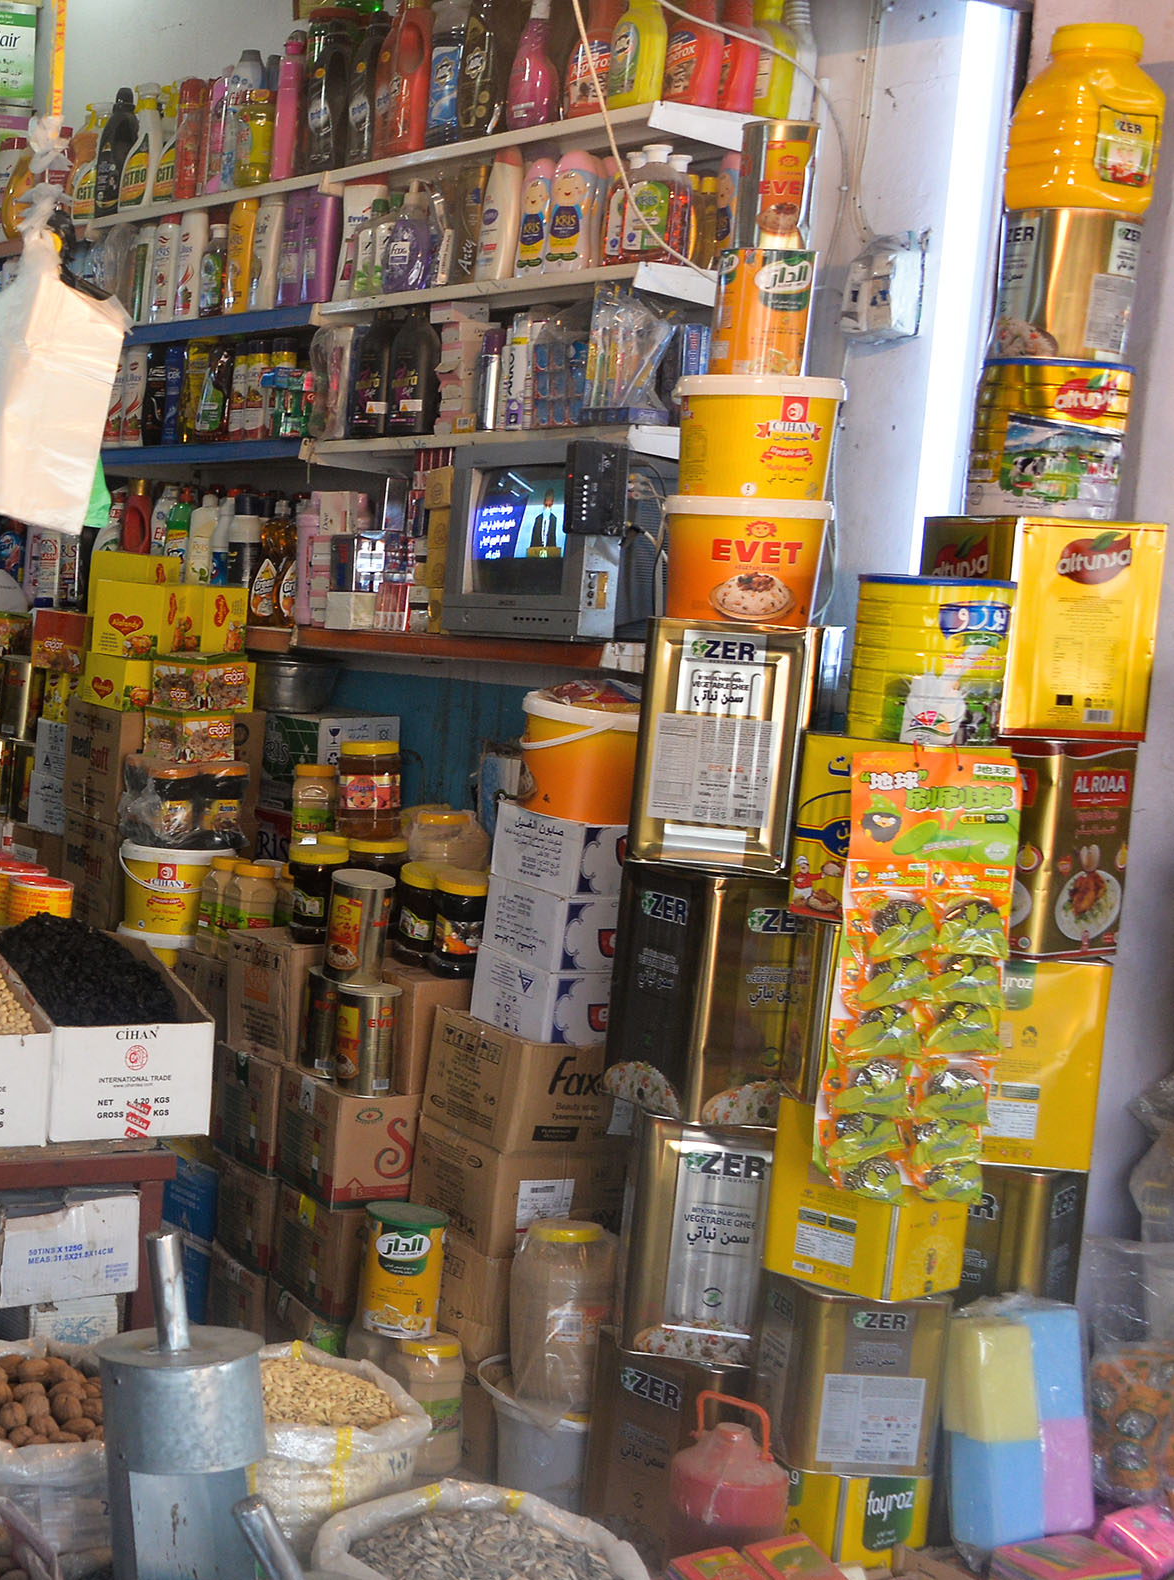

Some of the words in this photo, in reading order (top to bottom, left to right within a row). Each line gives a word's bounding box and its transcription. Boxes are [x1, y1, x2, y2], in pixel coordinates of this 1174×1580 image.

[1120, 121, 1142, 135] ZER
[555, 214, 577, 227] KRIS
[765, 262, 808, 290] الدار
[772, 421, 813, 433] CIHAN
[711, 538, 803, 565] EVET
[1056, 546, 1133, 576] altunsa
[949, 606, 1007, 634] يورو
[705, 639, 756, 663] ZER
[691, 680, 730, 692] VEGETABLE
[731, 683, 750, 694] GHEE
[693, 689, 719, 707] نباتي
[720, 690, 745, 706] سمن
[1074, 775, 1089, 793] AL
[1090, 775, 1126, 793] ROAA
[650, 892, 688, 926] ZER
[761, 907, 796, 934] ZE
[1001, 973, 1034, 993] yroz
[98, 1076, 145, 1084] INTERNATIONAL
[146, 1074, 172, 1083] TRADE
[97, 1098, 115, 1107] NET
[153, 1096, 170, 1105] KGS
[96, 1110, 124, 1120] GROSS
[152, 1108, 170, 1117] KGS
[701, 1151, 767, 1181] ZER
[683, 1214, 733, 1228] VEGETABLE
[733, 1218, 757, 1231] GHEE
[687, 1225, 717, 1246] نباتي
[720, 1231, 751, 1246] سمن
[383, 1235, 425, 1256] الدار
[864, 1312, 908, 1331] ZER
[633, 1370, 682, 1411] ZER
[867, 1489, 915, 1522] fayroz
